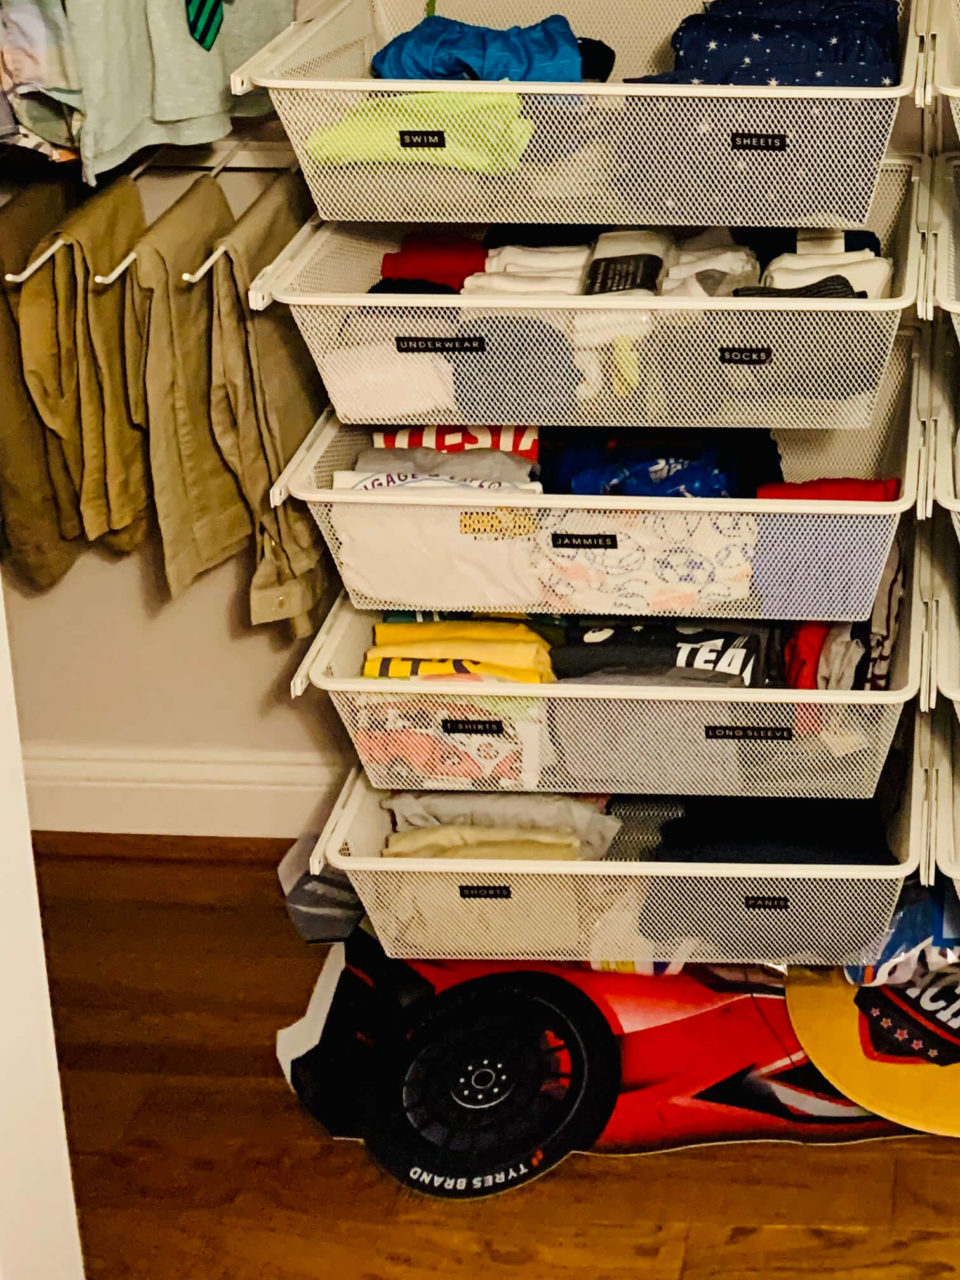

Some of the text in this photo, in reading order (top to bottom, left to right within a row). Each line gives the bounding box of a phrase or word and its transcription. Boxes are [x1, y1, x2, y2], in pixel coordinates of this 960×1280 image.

[403, 134, 440, 144] SWIM
[735, 136, 781, 147] SHEETS
[399, 340, 480, 349] UNDERWEAR
[724, 351, 767, 361] SOCKS
[555, 537, 613, 546] JAMMIES
[708, 728, 790, 738] LONG SLEEVE
[408, 1162, 529, 1190] TYRES BRAND
